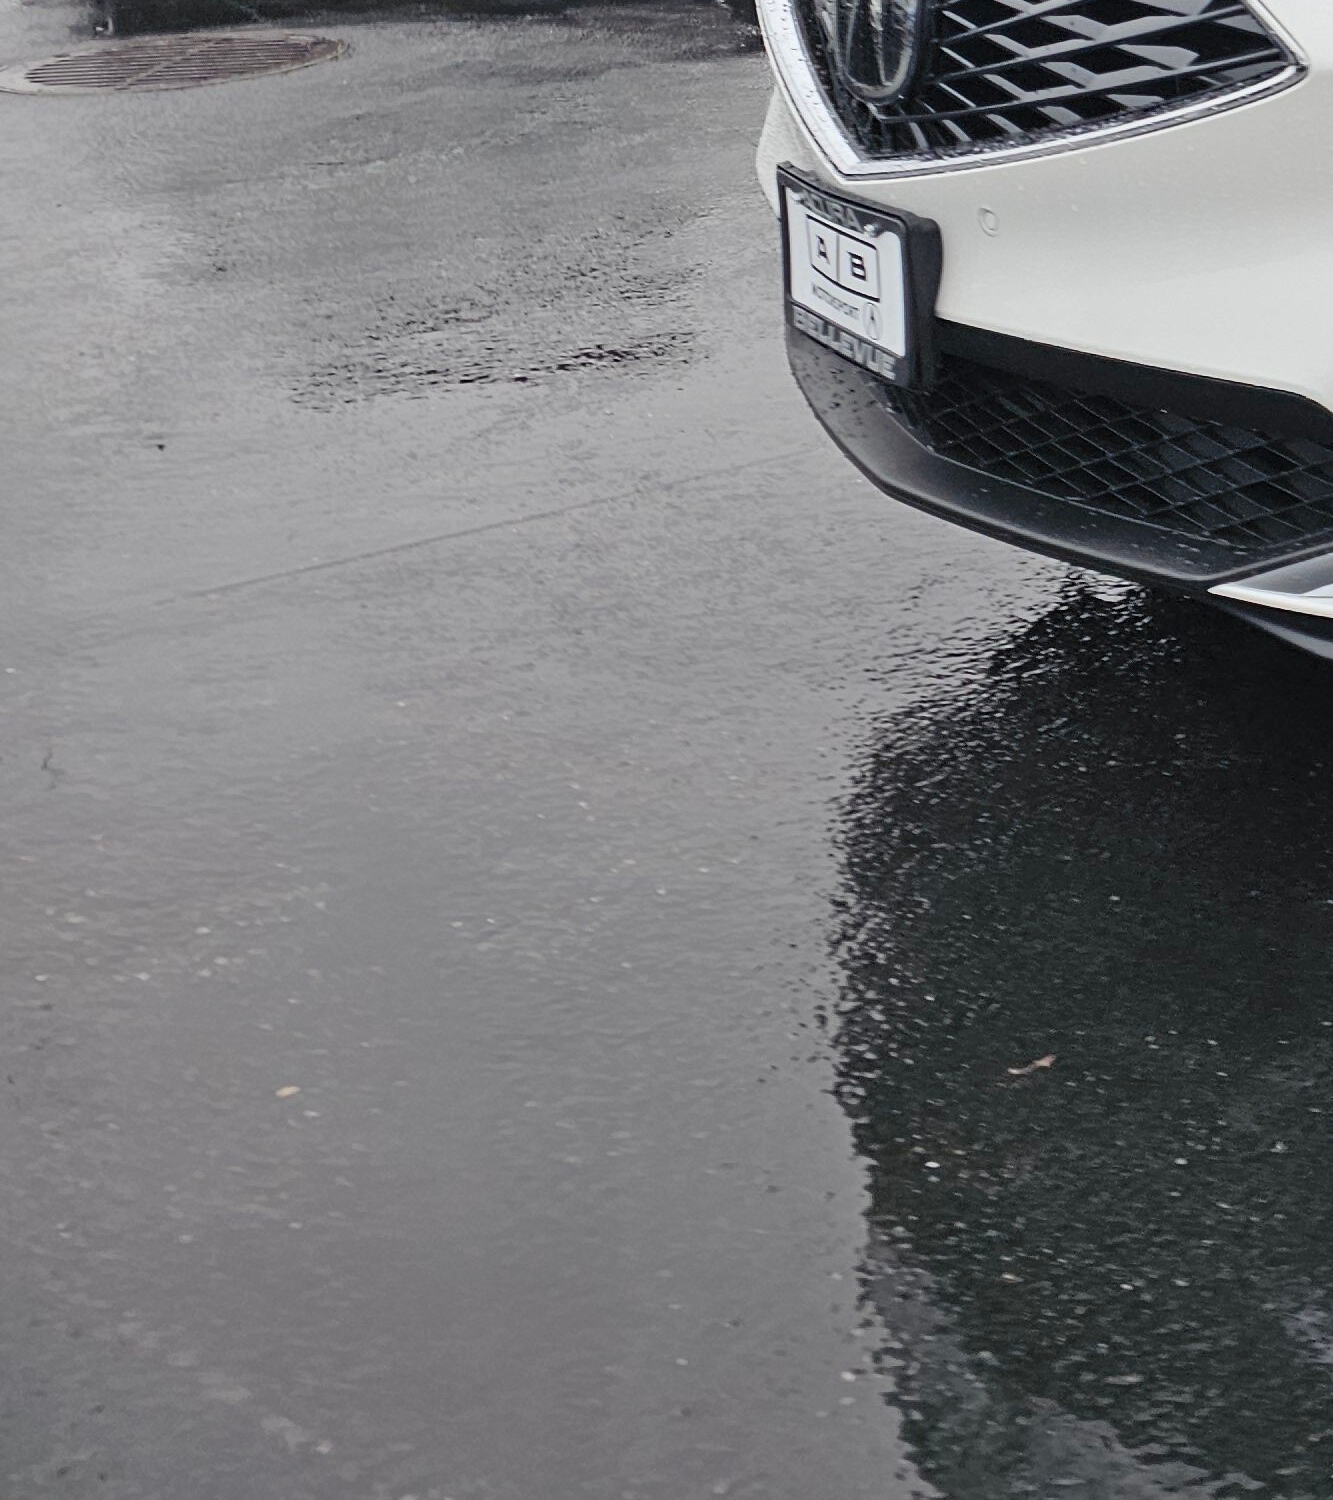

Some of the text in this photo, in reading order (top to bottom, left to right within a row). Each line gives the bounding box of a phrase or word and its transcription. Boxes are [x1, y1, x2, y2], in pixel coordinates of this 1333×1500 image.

[798, 189, 865, 233] URA
[847, 250, 867, 281] B
[792, 304, 897, 381] BELLEVUE
